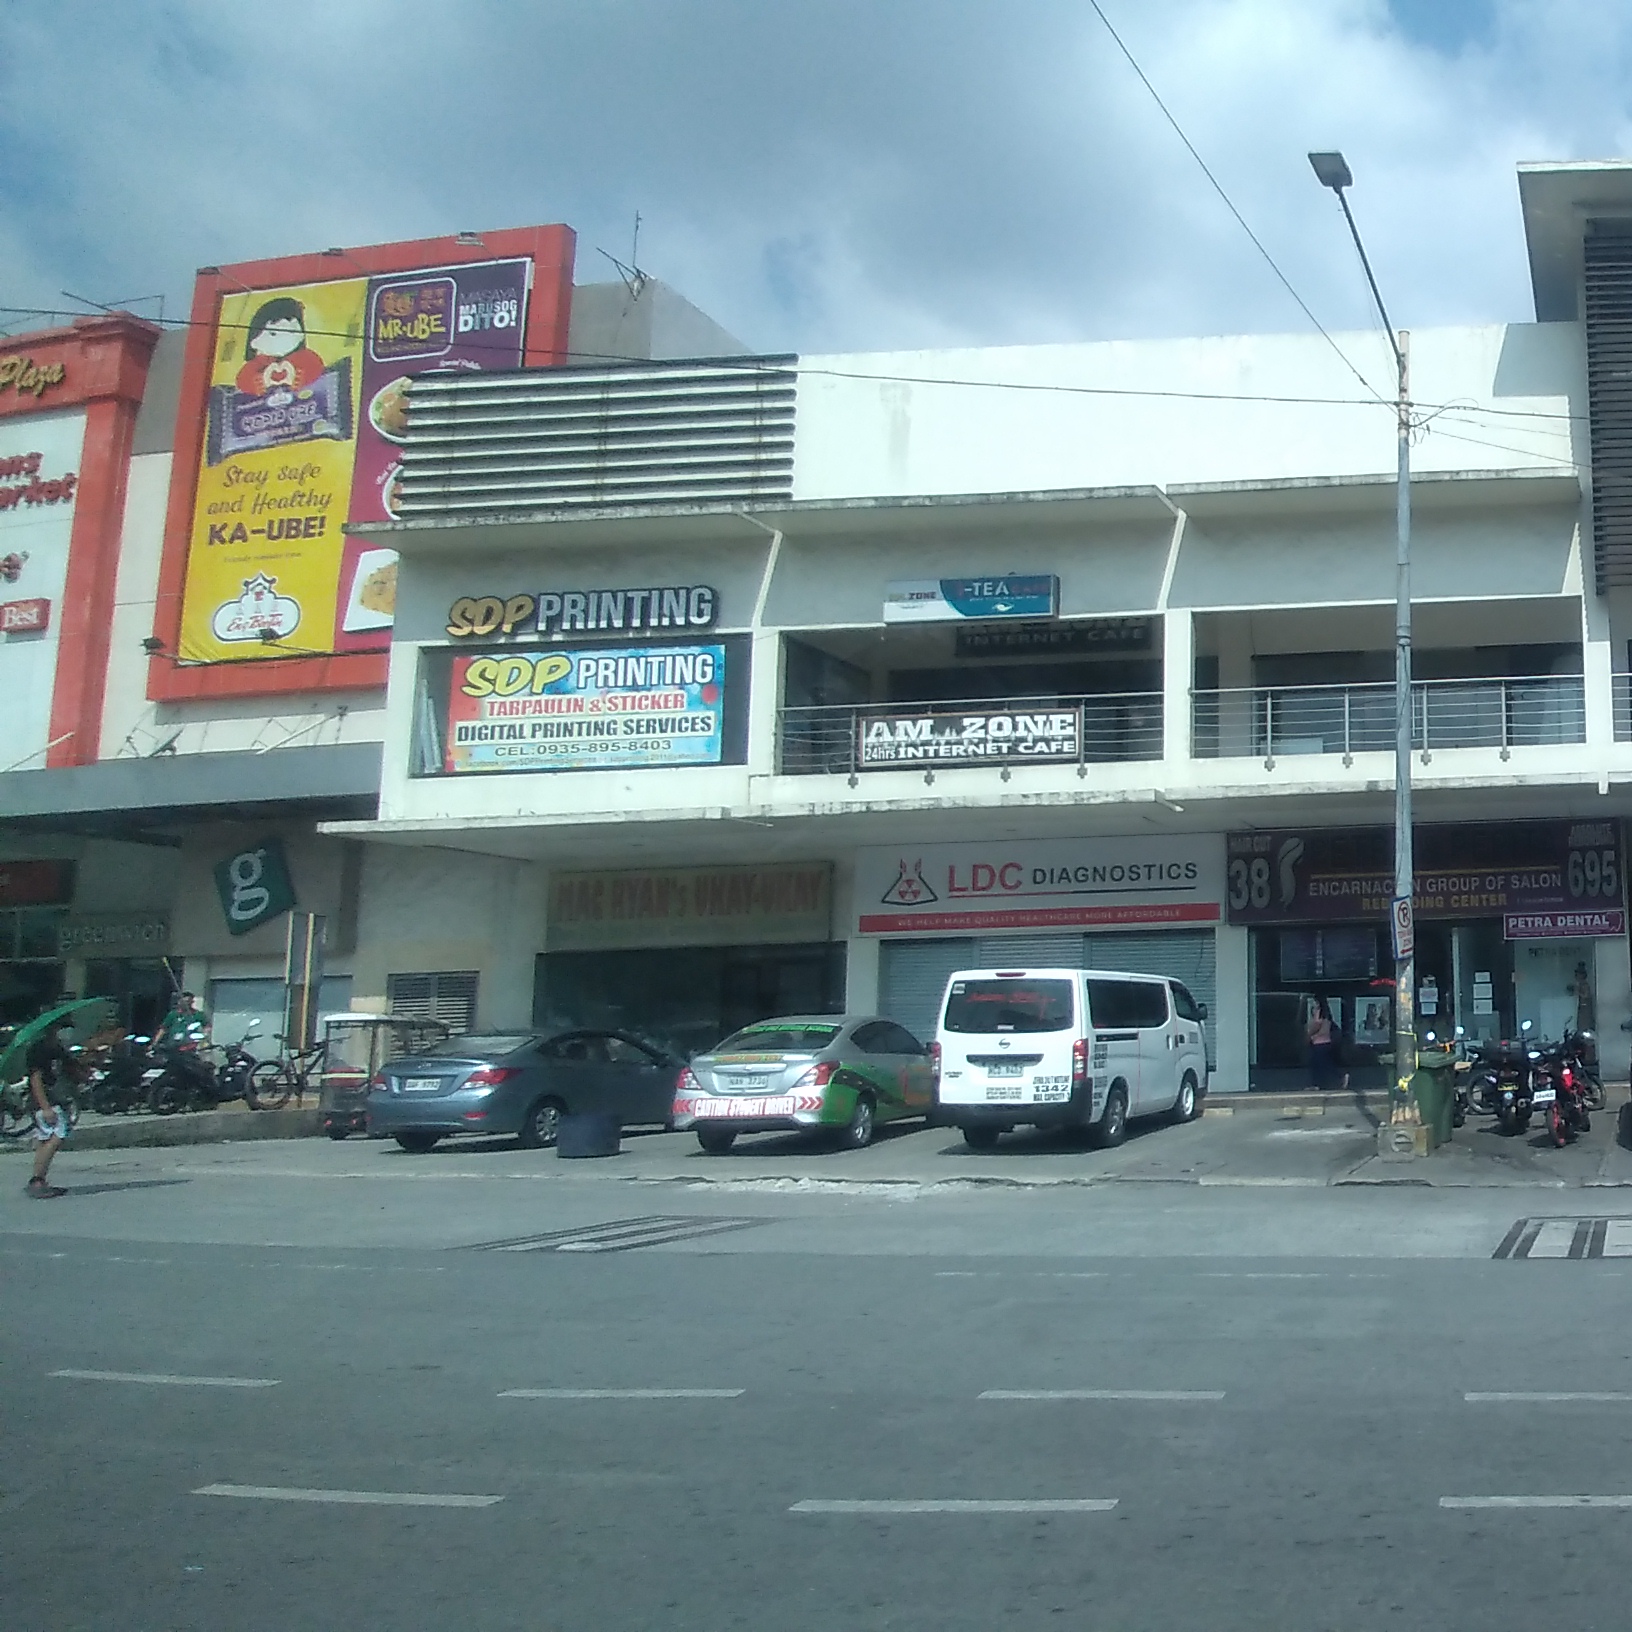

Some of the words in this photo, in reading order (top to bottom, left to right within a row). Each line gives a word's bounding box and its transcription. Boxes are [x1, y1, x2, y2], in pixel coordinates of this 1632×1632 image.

[459, 311, 516, 332] DITO!
[223, 465, 269, 490] Stay
[277, 463, 321, 486] safe
[207, 495, 245, 515] and
[251, 489, 333, 515] Healthy
[208, 516, 327, 546] KA-UBE!
[3, 606, 40, 628] Best
[446, 594, 535, 637] SDP
[536, 585, 715, 631] PRINTING
[461, 655, 573, 697] SDP
[577, 654, 714, 689] PRINTING
[487, 697, 585, 717] TARPAULIN
[589, 699, 602, 713] &
[606, 694, 686, 713] STICKER
[457, 723, 527, 742] DIGITAL
[530, 720, 618, 740] PRINTING
[622, 716, 712, 736] SERVICES
[866, 719, 934, 743] AM
[962, 713, 1075, 739] ZONE
[865, 746, 896, 761] 24hrs
[897, 742, 1013, 759] INTERNET
[1017, 740, 1076, 754] CAFE
[229, 848, 270, 921] g
[948, 862, 1023, 892] LDC
[1032, 862, 1198, 885] DIAGNOSTICS
[1229, 857, 1271, 910] 38
[1309, 877, 1421, 896] ENCARNACN
[1426, 875, 1480, 892] GROUP
[1486, 875, 1505, 890] OF
[1511, 873, 1562, 889] SALON
[1568, 850, 1618, 898] 695
[1451, 893, 1508, 908] CENTER
[1508, 916, 1552, 928] PETRA
[1557, 914, 1609, 927] DENTAL
[1033, 1084, 1069, 1093] 1342
[695, 1099, 729, 1117] CAUTION
[730, 1098, 764, 1116] STUDENT
[765, 1097, 795, 1115] DRIVER
